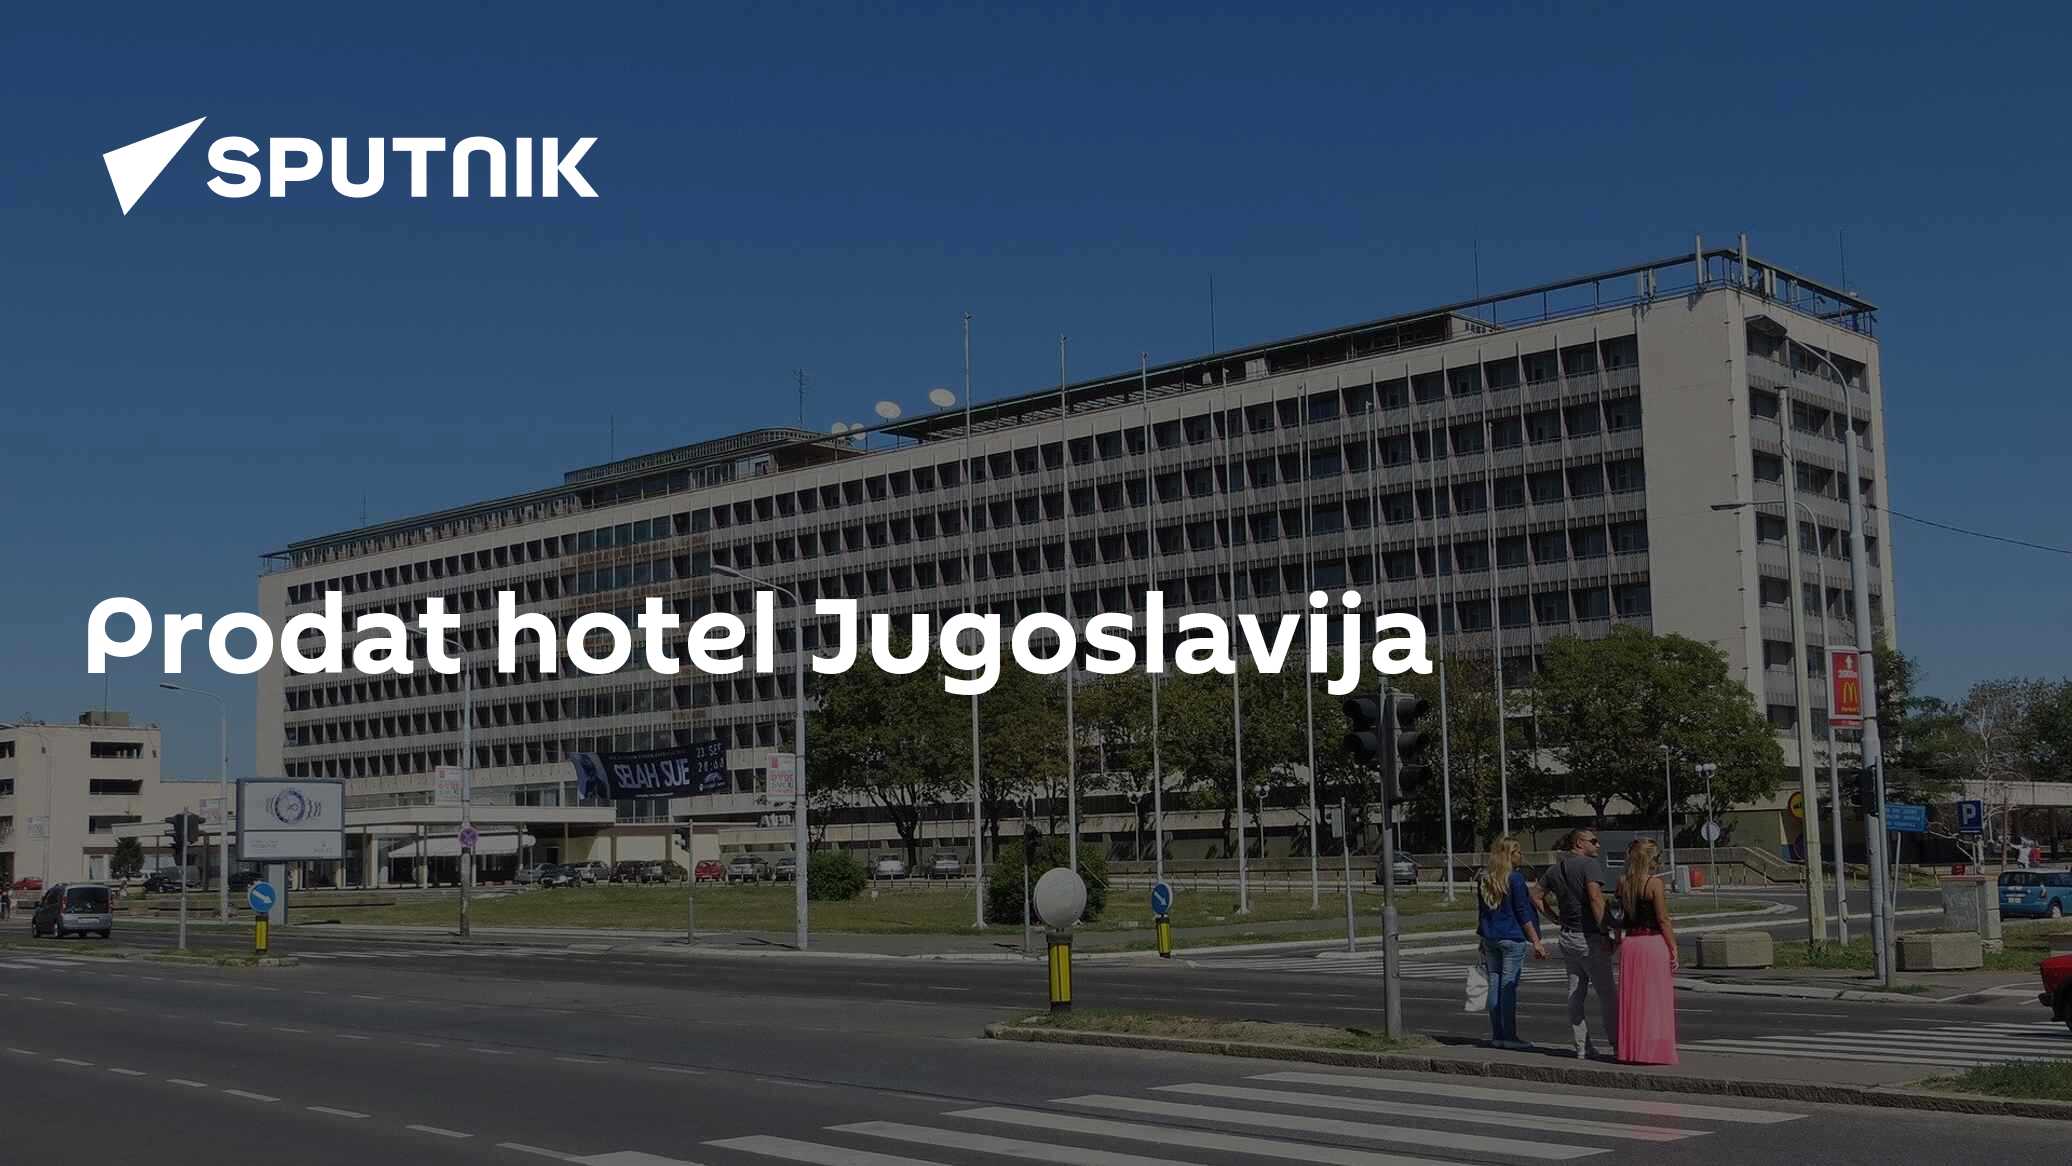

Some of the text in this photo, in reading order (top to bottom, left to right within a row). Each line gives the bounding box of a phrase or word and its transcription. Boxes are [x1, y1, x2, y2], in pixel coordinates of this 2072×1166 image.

[614, 763, 661, 789] SELAH
[660, 758, 690, 787] SUE
[1962, 804, 1976, 825] P
